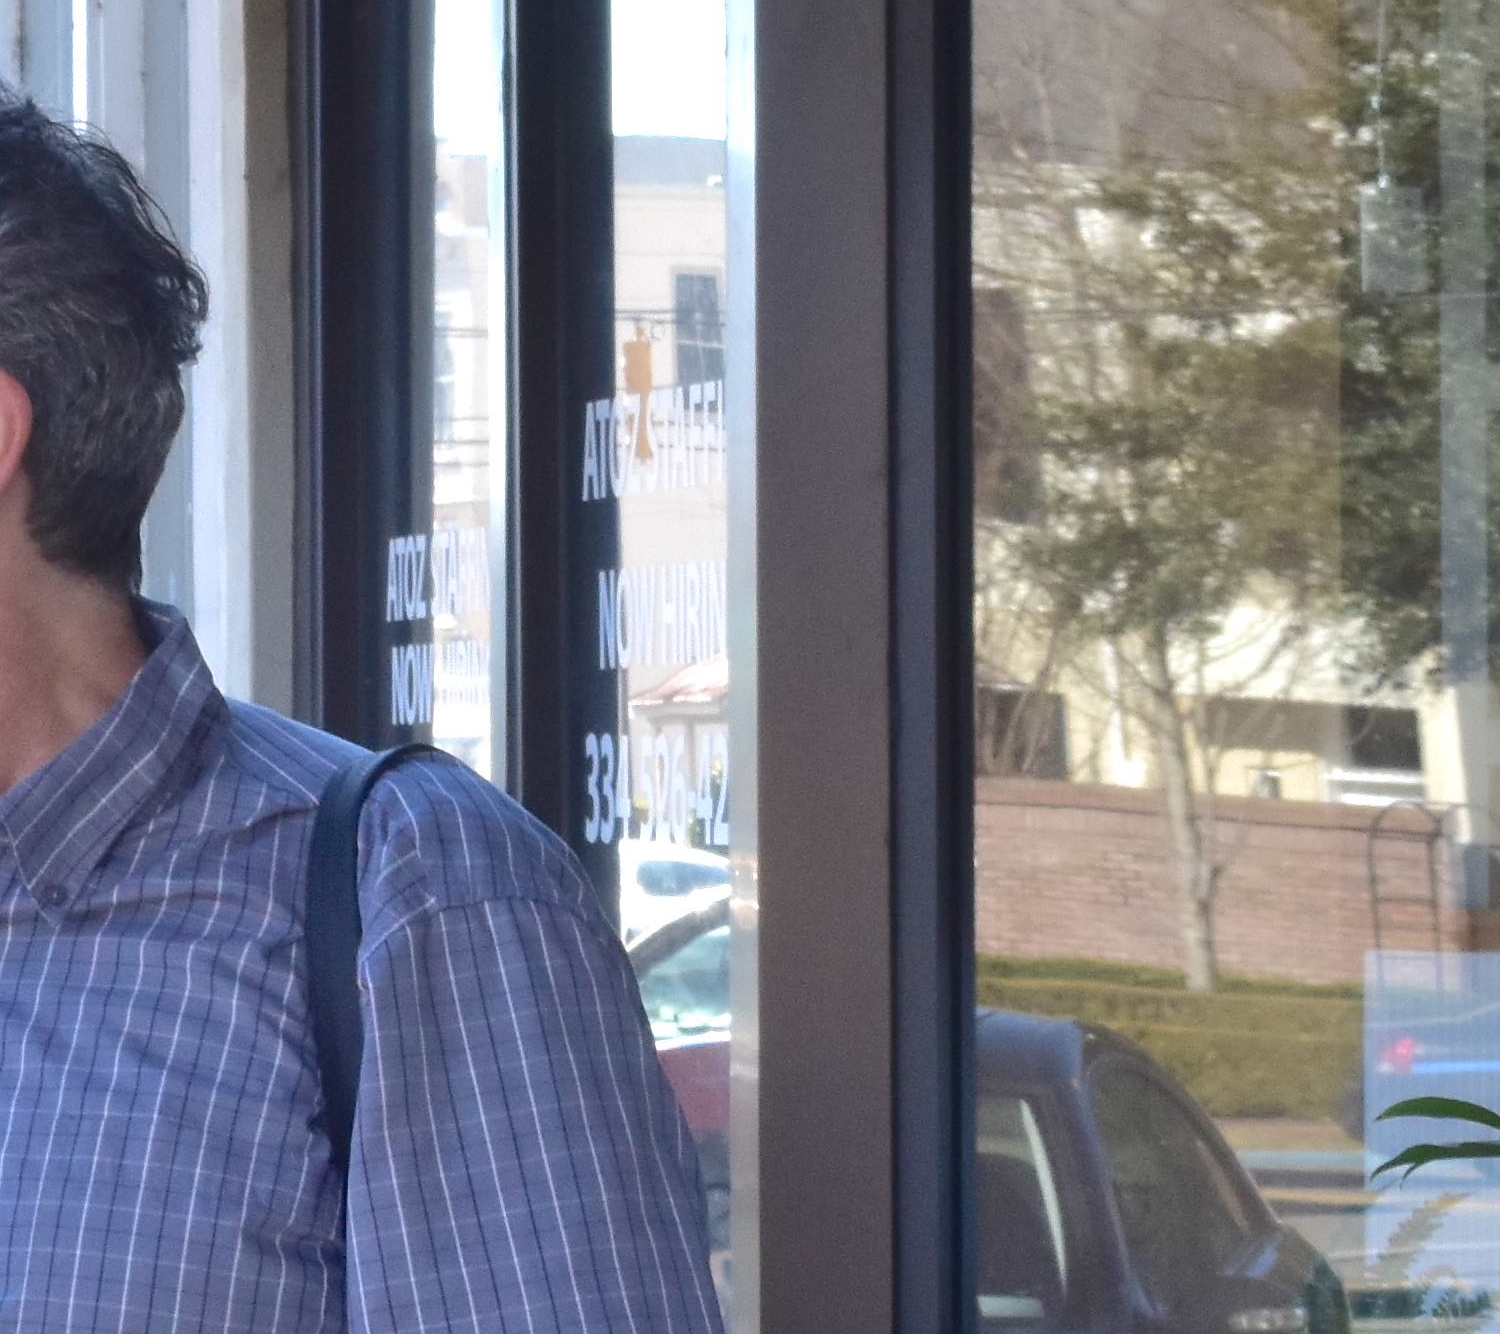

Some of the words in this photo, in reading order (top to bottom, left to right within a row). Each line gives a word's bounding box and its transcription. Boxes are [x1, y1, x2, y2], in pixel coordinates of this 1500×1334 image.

[598, 563, 655, 670] NOW
[391, 642, 434, 727] NOW
[585, 731, 730, 845] 334526-42
